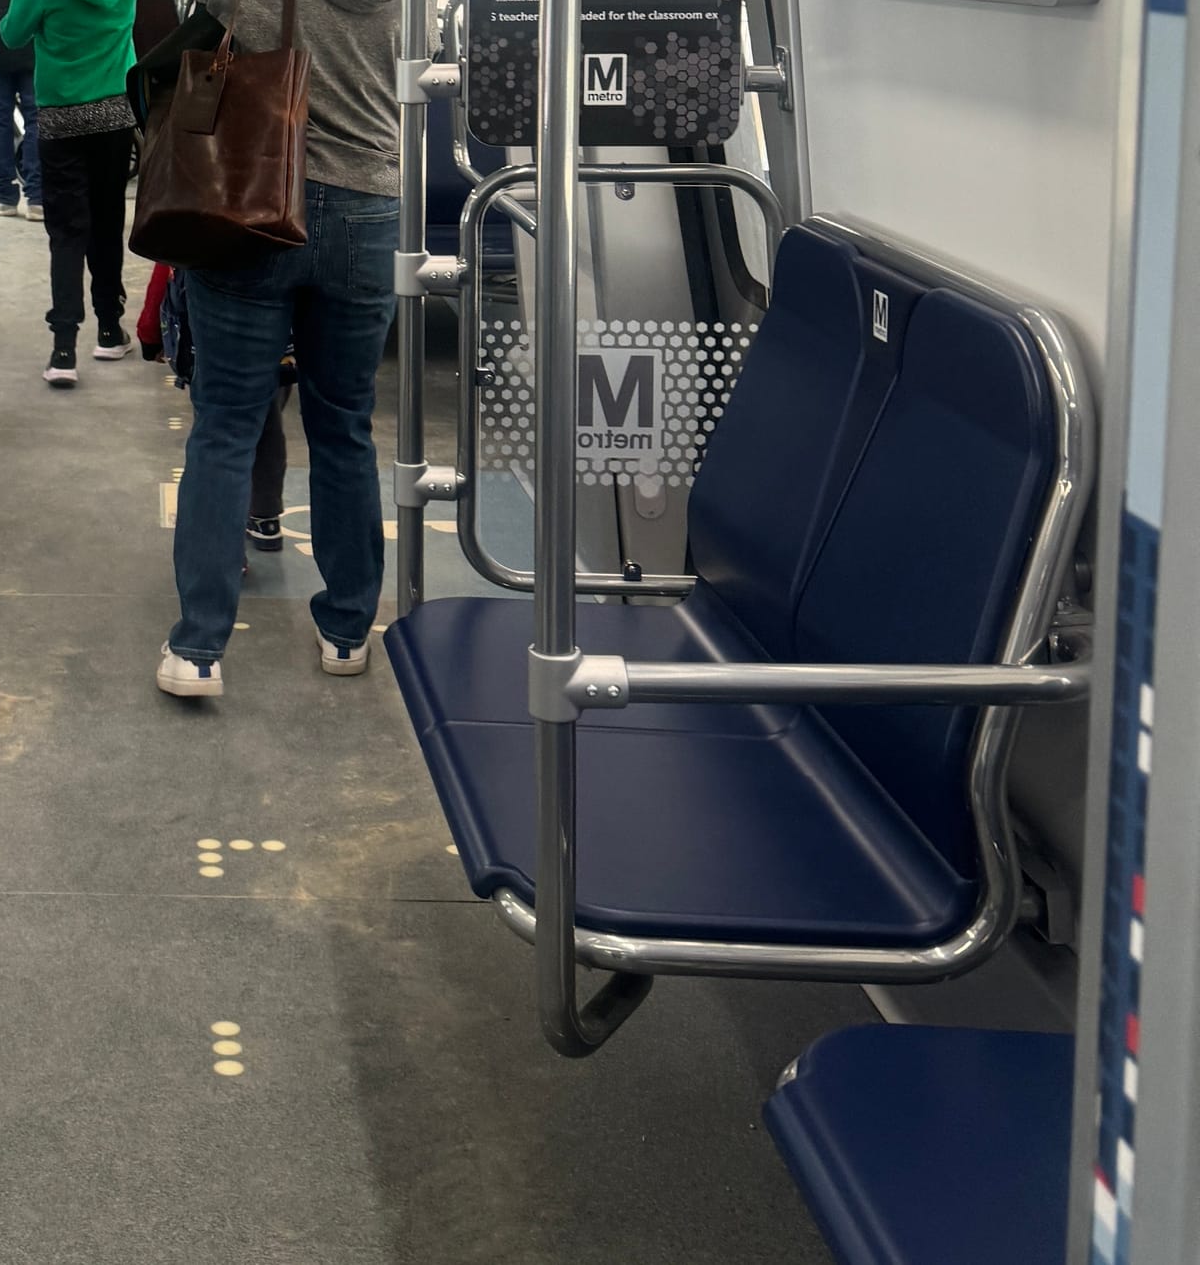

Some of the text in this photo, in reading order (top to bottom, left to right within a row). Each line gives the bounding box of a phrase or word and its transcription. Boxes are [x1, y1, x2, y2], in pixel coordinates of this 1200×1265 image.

[499, 12, 539, 21] teacher
[580, 10, 719, 21] aded for the classroom ex
[587, 57, 623, 91] M
[587, 91, 623, 102] metro
[875, 293, 887, 330] M
